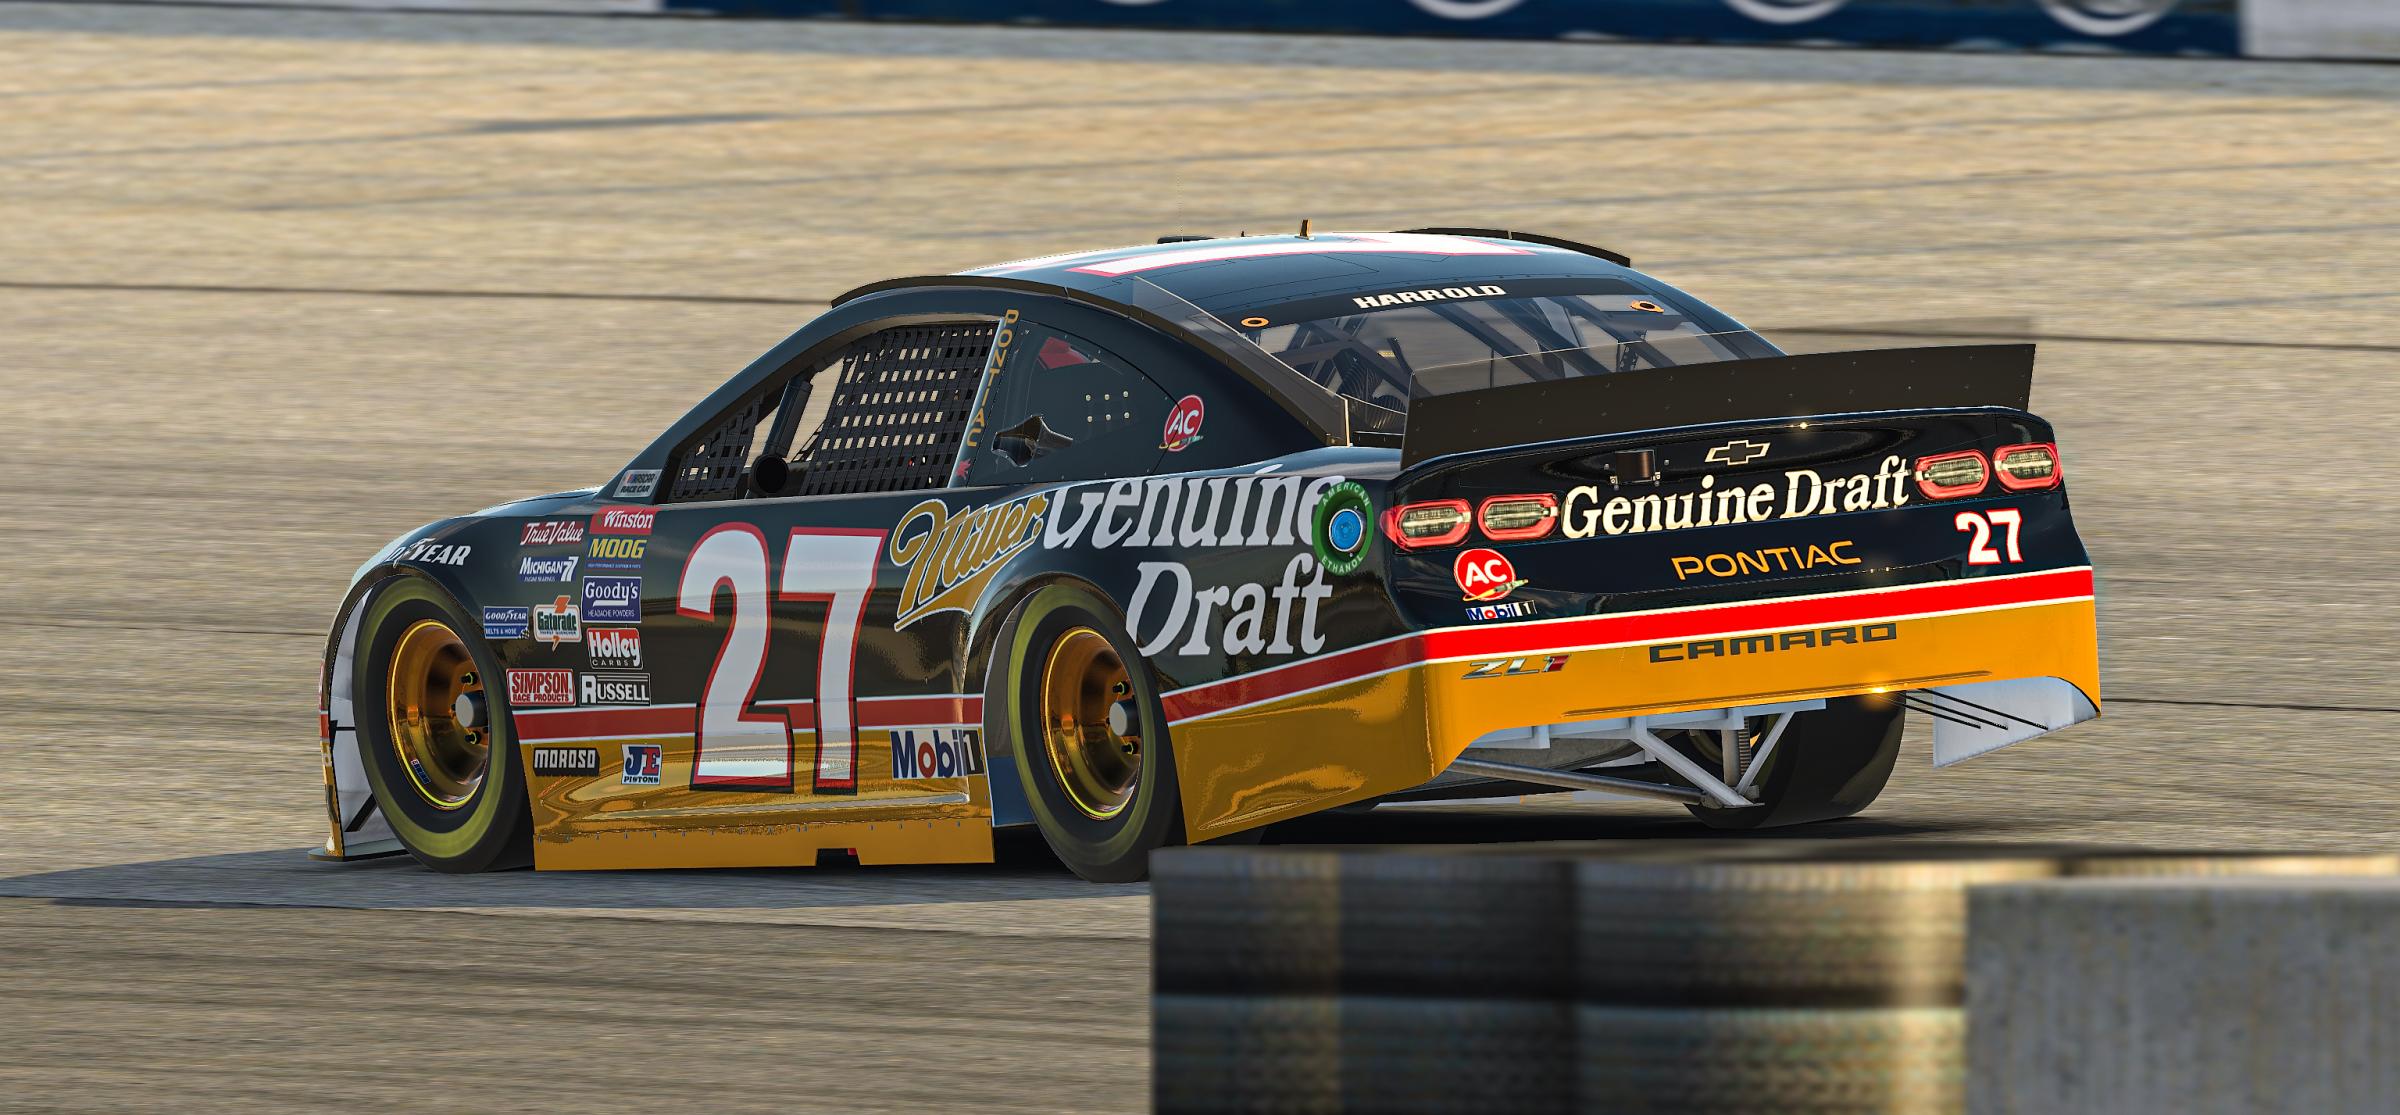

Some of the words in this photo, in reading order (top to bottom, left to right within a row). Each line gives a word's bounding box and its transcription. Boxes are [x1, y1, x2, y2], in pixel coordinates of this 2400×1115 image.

[1352, 285, 1506, 309] HARROLD
[966, 309, 1019, 447] PONTIAC
[1167, 409, 1199, 435] AC
[621, 485, 638, 493] RACE
[637, 485, 650, 493] CAR
[1323, 482, 1371, 506] AMERICAN
[1560, 475, 1775, 539] Genuine
[1780, 455, 1909, 520] Draft
[603, 510, 654, 529] Winston
[520, 522, 550, 546] True
[545, 521, 584, 545] Value
[1954, 507, 2024, 566] 27
[587, 538, 648, 559] MOOG
[889, 498, 1049, 619] Miller
[1671, 540, 1862, 580] PONTIAC
[519, 556, 563, 575] MICHIGAN
[560, 555, 580, 582] 77
[1321, 555, 1364, 574] ETHANOL
[1465, 559, 1508, 588] AC
[585, 582, 639, 604] Goody's
[1126, 552, 1333, 658] Draft
[485, 609, 527, 622] GOODYEAR
[537, 611, 578, 631] Gatorade
[588, 609, 611, 618] HEADACHE
[612, 609, 635, 618] POWDERS
[1466, 603, 1517, 621] Mobil
[485, 627, 499, 636] BELTS
[504, 627, 518, 635] HOSE
[1649, 623, 1898, 664] CAMARO
[588, 631, 641, 668] Holley
[675, 521, 890, 796] 27
[591, 659, 630, 668] CARBS
[1461, 654, 1571, 680] ZL1
[511, 672, 569, 694] SIMPSON
[581, 675, 650, 704] RUSSELL
[513, 693, 531, 702] RACE
[533, 693, 569, 702] PRODUCTS
[534, 749, 597, 769] MOROSO
[624, 746, 661, 776] JE
[890, 729, 968, 779] Mobil
